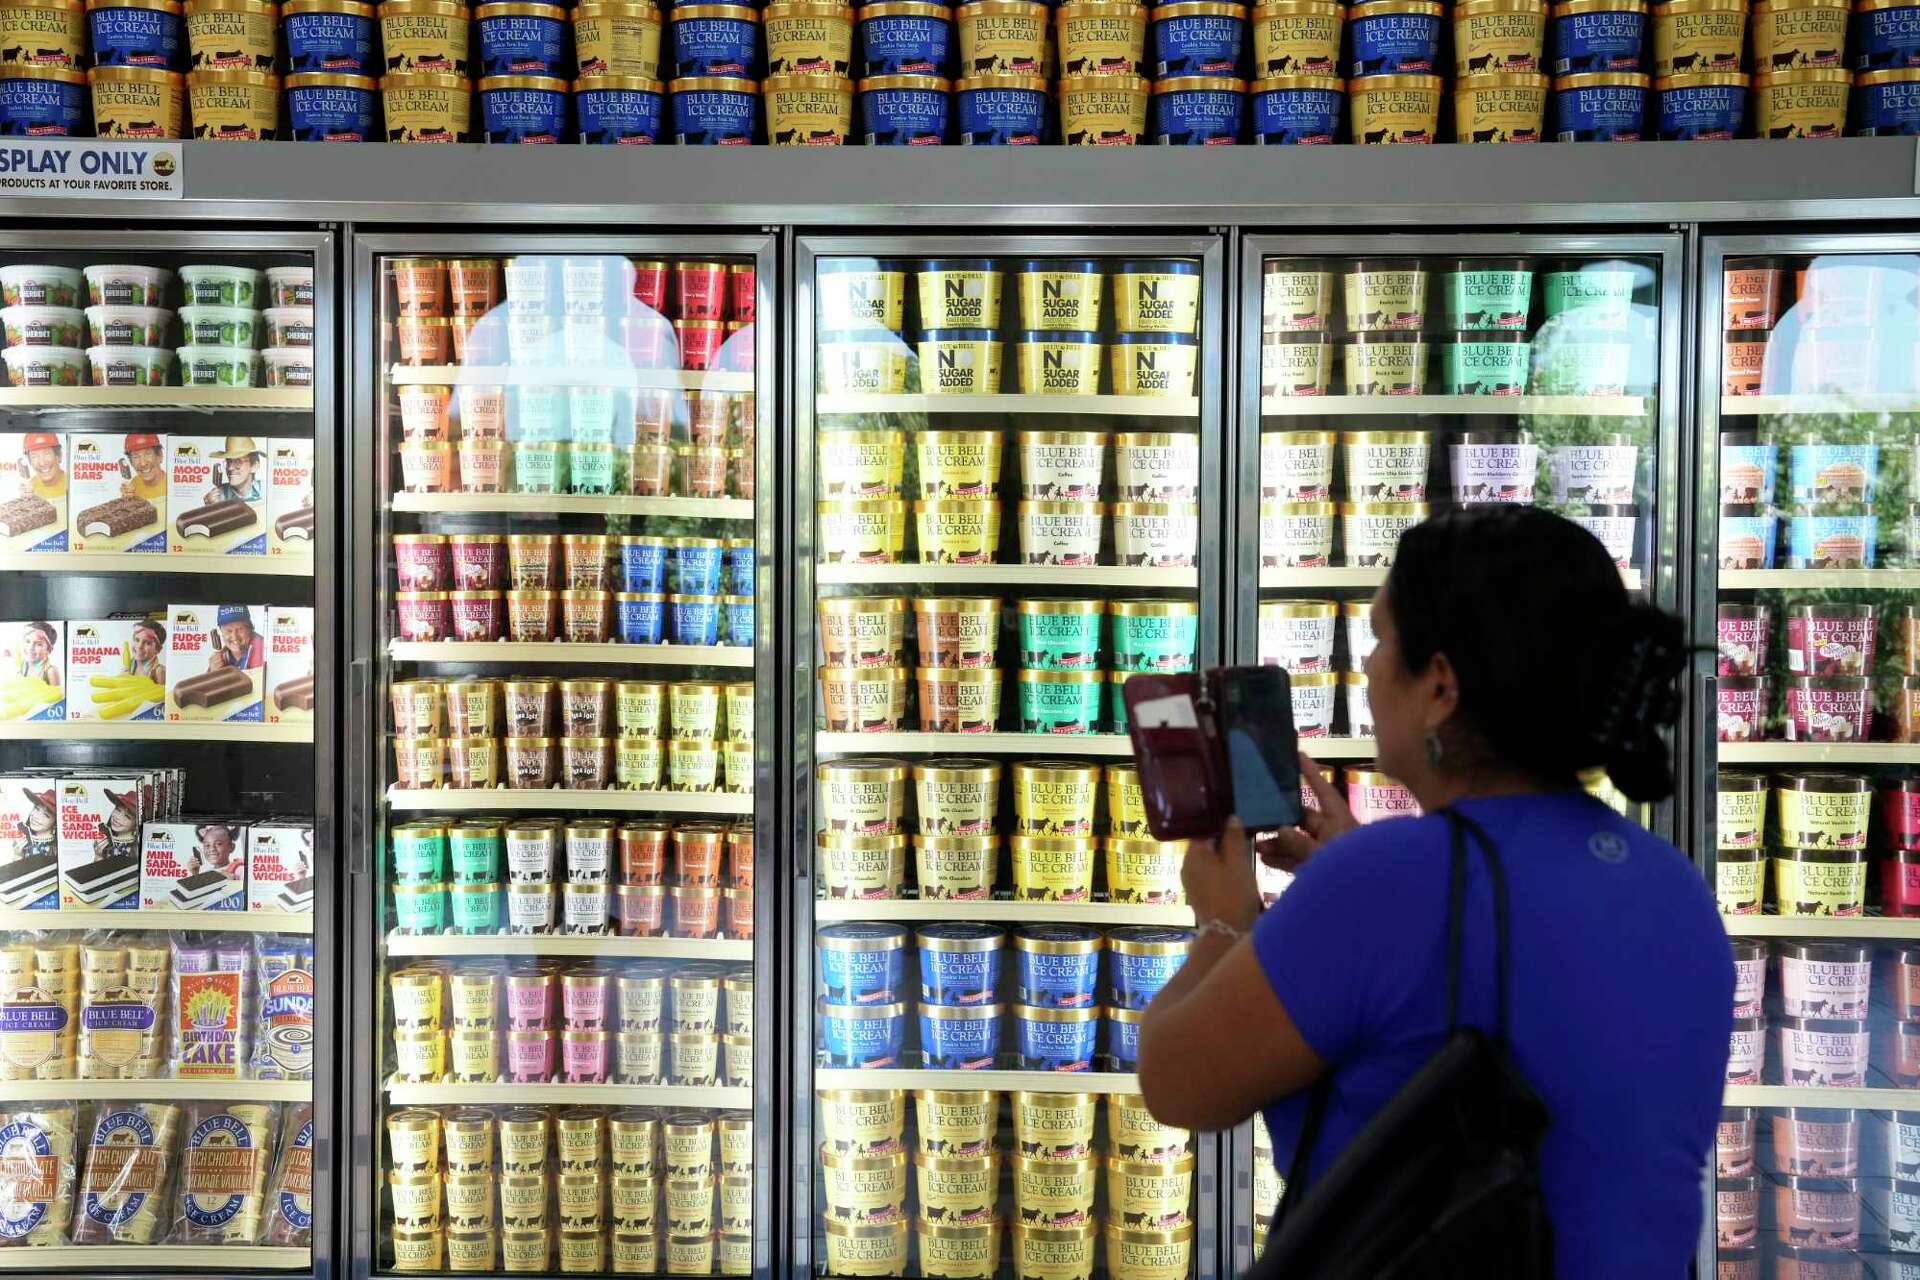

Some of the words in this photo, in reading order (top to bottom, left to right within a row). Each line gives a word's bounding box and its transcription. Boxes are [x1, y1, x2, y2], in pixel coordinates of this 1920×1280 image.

[96, 11, 125, 22] BLUE
[128, 11, 161, 23] BELL
[1776, 12, 1812, 24] BLUE
[1816, 10, 1842, 22] BELL
[98, 22, 113, 34] ICE
[115, 22, 161, 35] CREAM
[976, 18, 1009, 30] BLUE
[1013, 18, 1038, 30] BELL
[1270, 18, 1302, 31] BLUE
[1307, 18, 1332, 30] BELL
[1776, 23, 1796, 35] ICE
[1800, 22, 1841, 33] CREAM
[977, 30, 997, 41] ICE
[999, 29, 1038, 41] CREAM
[1270, 30, 1288, 42] ICE
[1292, 30, 1332, 41] CREAM
[587, 93, 617, 104] BLUE
[622, 93, 649, 104] BELL
[1663, 89, 1695, 103] BLUE
[1700, 88, 1730, 99] BELL
[588, 103, 605, 115] ICE
[607, 103, 649, 116] CREAM
[1664, 102, 1680, 113] ICE
[1684, 100, 1729, 112] CREAM
[0, 149, 71, 173] SPLAY
[80, 151, 148, 174] ONLY
[50, 179, 60, 188] AT
[63, 180, 90, 189] YOUR
[94, 181, 137, 190] FAVORITE
[140, 181, 172, 191] STORE.
[946, 299, 981, 308] SUGAR
[1043, 299, 1079, 308] SUGAR
[1139, 301, 1174, 309] SUGAR
[946, 308, 981, 317] ADDED
[1043, 308, 1078, 317] ADDED
[287, 332, 312, 340] SHERBET
[74, 463, 118, 471] KRUNCH
[174, 466, 210, 474] MOOO
[273, 468, 308, 476] MOOO
[74, 472, 103, 480] BARS
[174, 475, 203, 483] BARS
[273, 477, 300, 485] BARS
[1808, 621, 1843, 631] BLUE
[1848, 621, 1873, 631] BELL
[173, 634, 208, 642] FUDGE
[273, 636, 307, 644] FUDGE
[1808, 632, 1828, 641] ICE
[1831, 632, 1872, 642] CREAM
[173, 642, 200, 650] BARS
[273, 645, 300, 653] BARS
[72, 656, 101, 664] POPS
[47, 706, 63, 718] 60
[62, 814, 101, 822] CREAM
[62, 823, 97, 831] SAND-
[146, 850, 173, 859] MINI
[253, 855, 279, 863] MINI
[146, 860, 181, 868] SAND-
[253, 864, 288, 873] SAND-
[146, 869, 188, 877] WICHES
[253, 873, 295, 881] WICHES
[220, 897, 239, 908] 100
[266, 996, 313, 1014] SUNDA
[0, 1011, 27, 1021] BLUE
[32, 1012, 56, 1021] BELL
[89, 1010, 117, 1019] BLUE
[121, 1010, 142, 1019] BELL
[931, 1020, 960, 1031] BLUE
[963, 1021, 990, 1030] BELL
[1027, 1023, 1057, 1034] BLUE
[1061, 1023, 1087, 1034] BELL
[183, 1031, 237, 1042] BIRTHDAY
[932, 1031, 948, 1041] ICE
[950, 1031, 991, 1041] CREAM
[1028, 1033, 1044, 1043] ICE
[1046, 1033, 1086, 1044] CREAM
[183, 1044, 235, 1064] CAKE
[95, 1116, 124, 1143] BLUE
[127, 1116, 151, 1145] BELL
[192, 1119, 220, 1146] BLUE
[222, 1119, 249, 1146] BELL
[928, 1172, 957, 1183] BLUE
[961, 1172, 987, 1183] BELL
[928, 1183, 944, 1194] ICE
[947, 1183, 987, 1194] CREAM
[199, 1198, 239, 1225] CREAM
[1024, 1240, 1053, 1252] BLUE
[1056, 1240, 1084, 1252] BELL
[1025, 1251, 1043, 1263] ICE
[1044, 1252, 1084, 1264] CREAM
